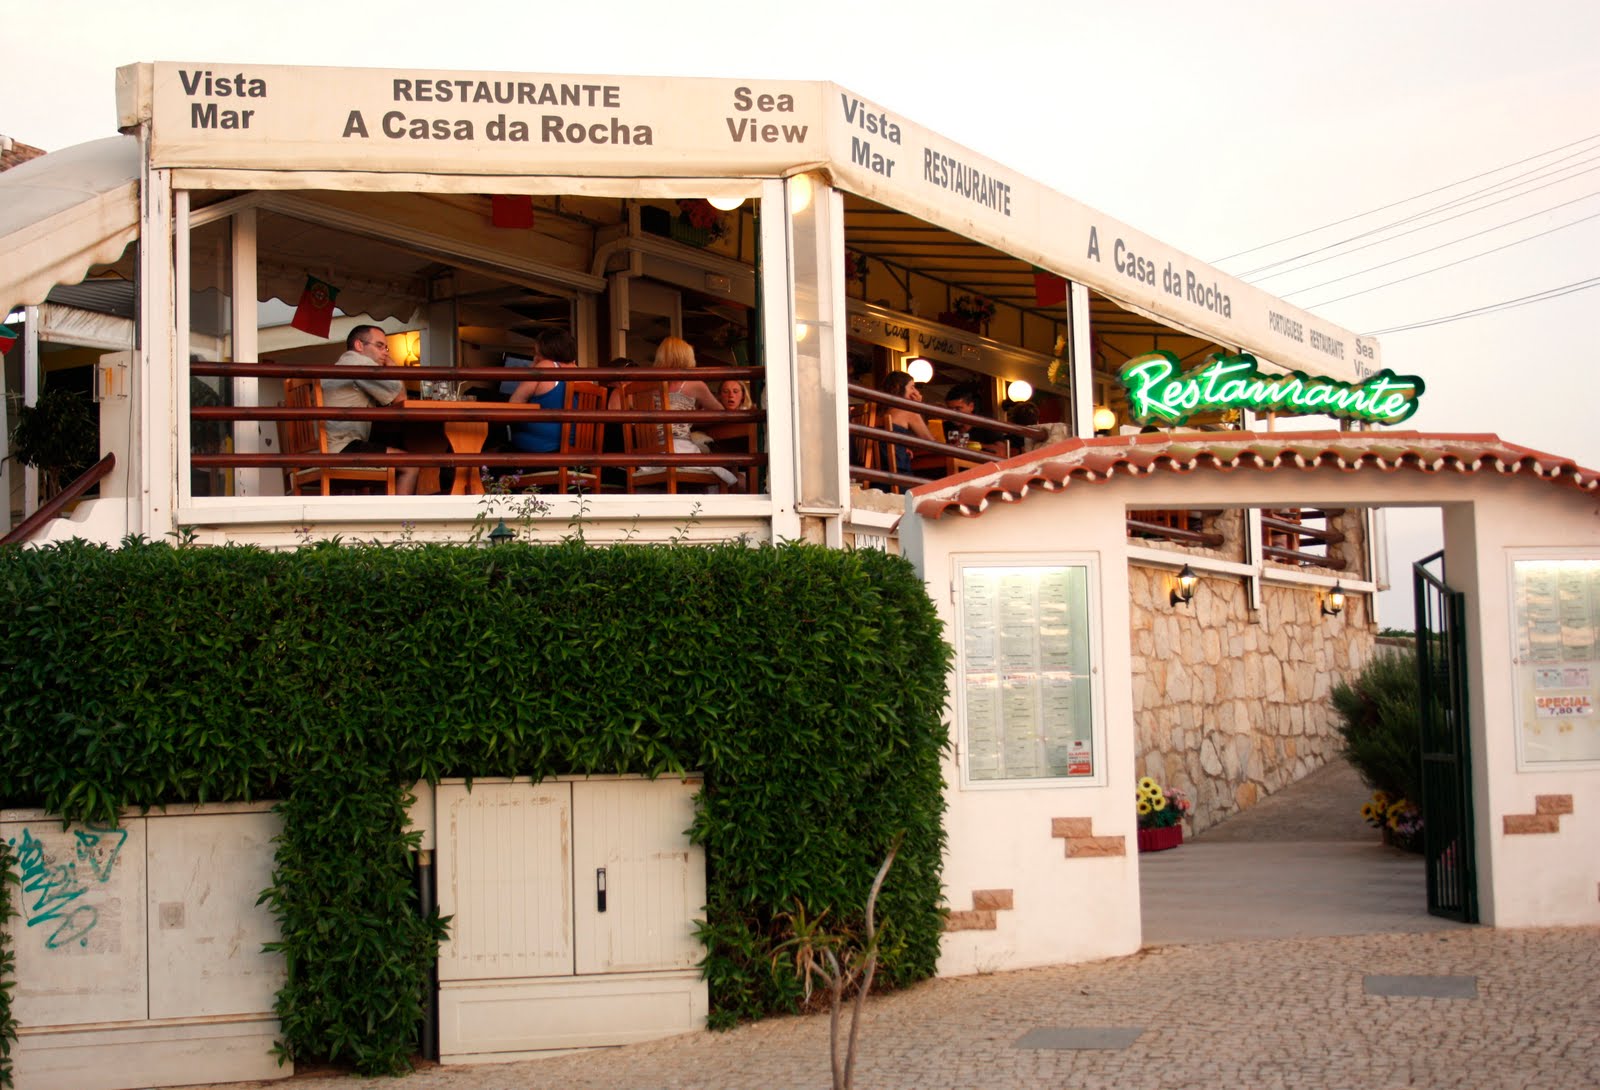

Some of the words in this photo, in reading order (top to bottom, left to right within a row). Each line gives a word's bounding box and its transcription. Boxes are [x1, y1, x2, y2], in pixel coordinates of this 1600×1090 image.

[179, 71, 267, 98] Vista
[393, 79, 621, 108] RESTAURANTE
[733, 87, 794, 113] Sea
[191, 103, 255, 130] Mar
[342, 111, 369, 138] A
[381, 111, 475, 141] Casa
[485, 114, 529, 142] da
[541, 116, 653, 146] Rocha
[726, 118, 808, 144] View
[841, 93, 901, 145] Vista
[851, 136, 895, 178] Mar
[924, 147, 1011, 217] RESTAURANTE
[1087, 226, 1100, 262] A
[1114, 238, 1155, 287] Casa
[1163, 261, 1182, 297] da
[1186, 269, 1231, 319] Rocha
[1269, 310, 1303, 343] PORTUGUESE
[1310, 329, 1344, 360] RESTAURANTE
[1356, 338, 1374, 359] Sea
[1128, 358, 1416, 418] Restaurante
[1537, 697, 1590, 708] SPECIAL
